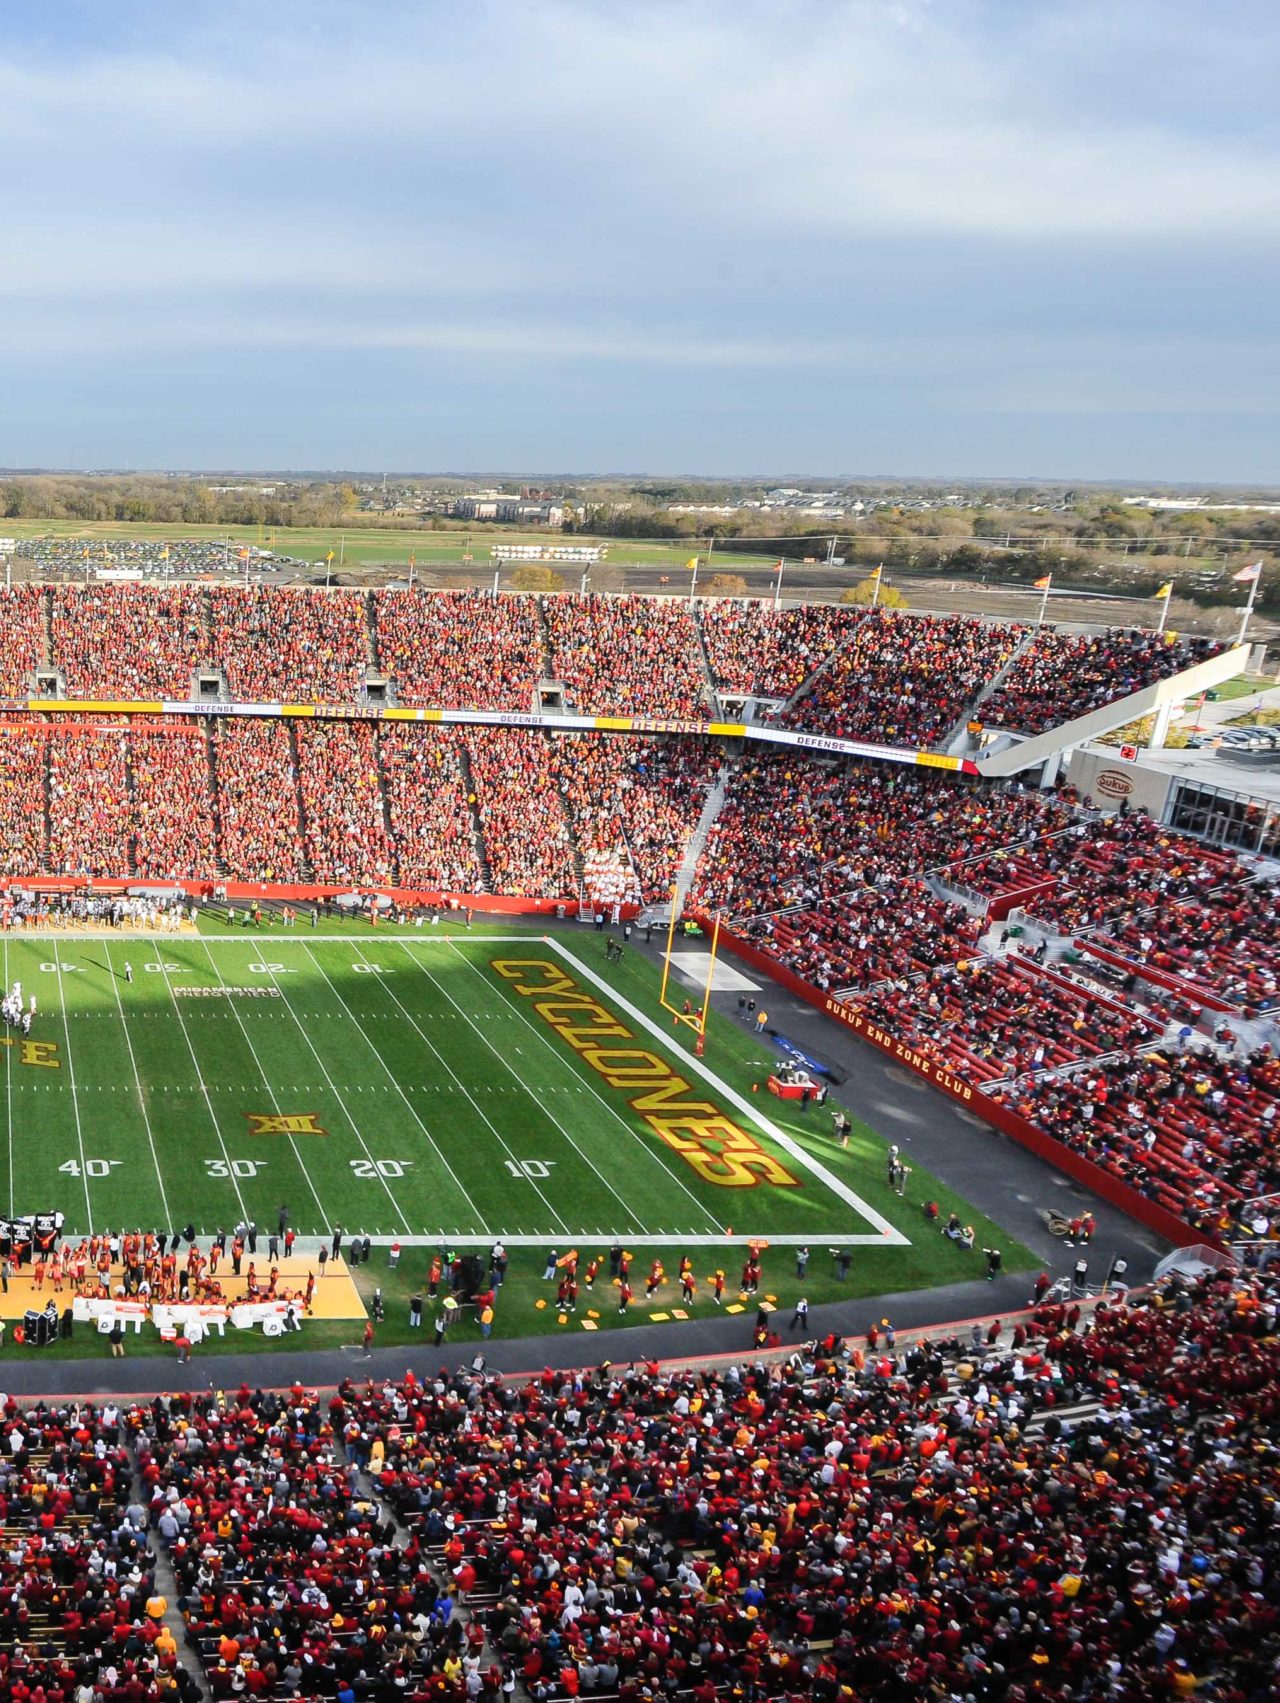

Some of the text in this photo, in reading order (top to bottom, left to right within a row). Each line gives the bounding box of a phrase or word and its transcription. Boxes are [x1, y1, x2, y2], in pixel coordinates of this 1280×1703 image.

[313, 708, 384, 718] DEFENSE
[501, 715, 544, 724] DEFENSE
[631, 721, 710, 733] DEFENSE
[797, 736, 846, 750] DEFENSE
[825, 999, 972, 1100] SUKUP END ZONE CLUB
[490, 959, 799, 1186] CYCLONES
[58, 1159, 110, 1177] 40
[204, 1160, 259, 1178] 30
[349, 1160, 405, 1178] 20
[504, 1160, 550, 1178] 10
